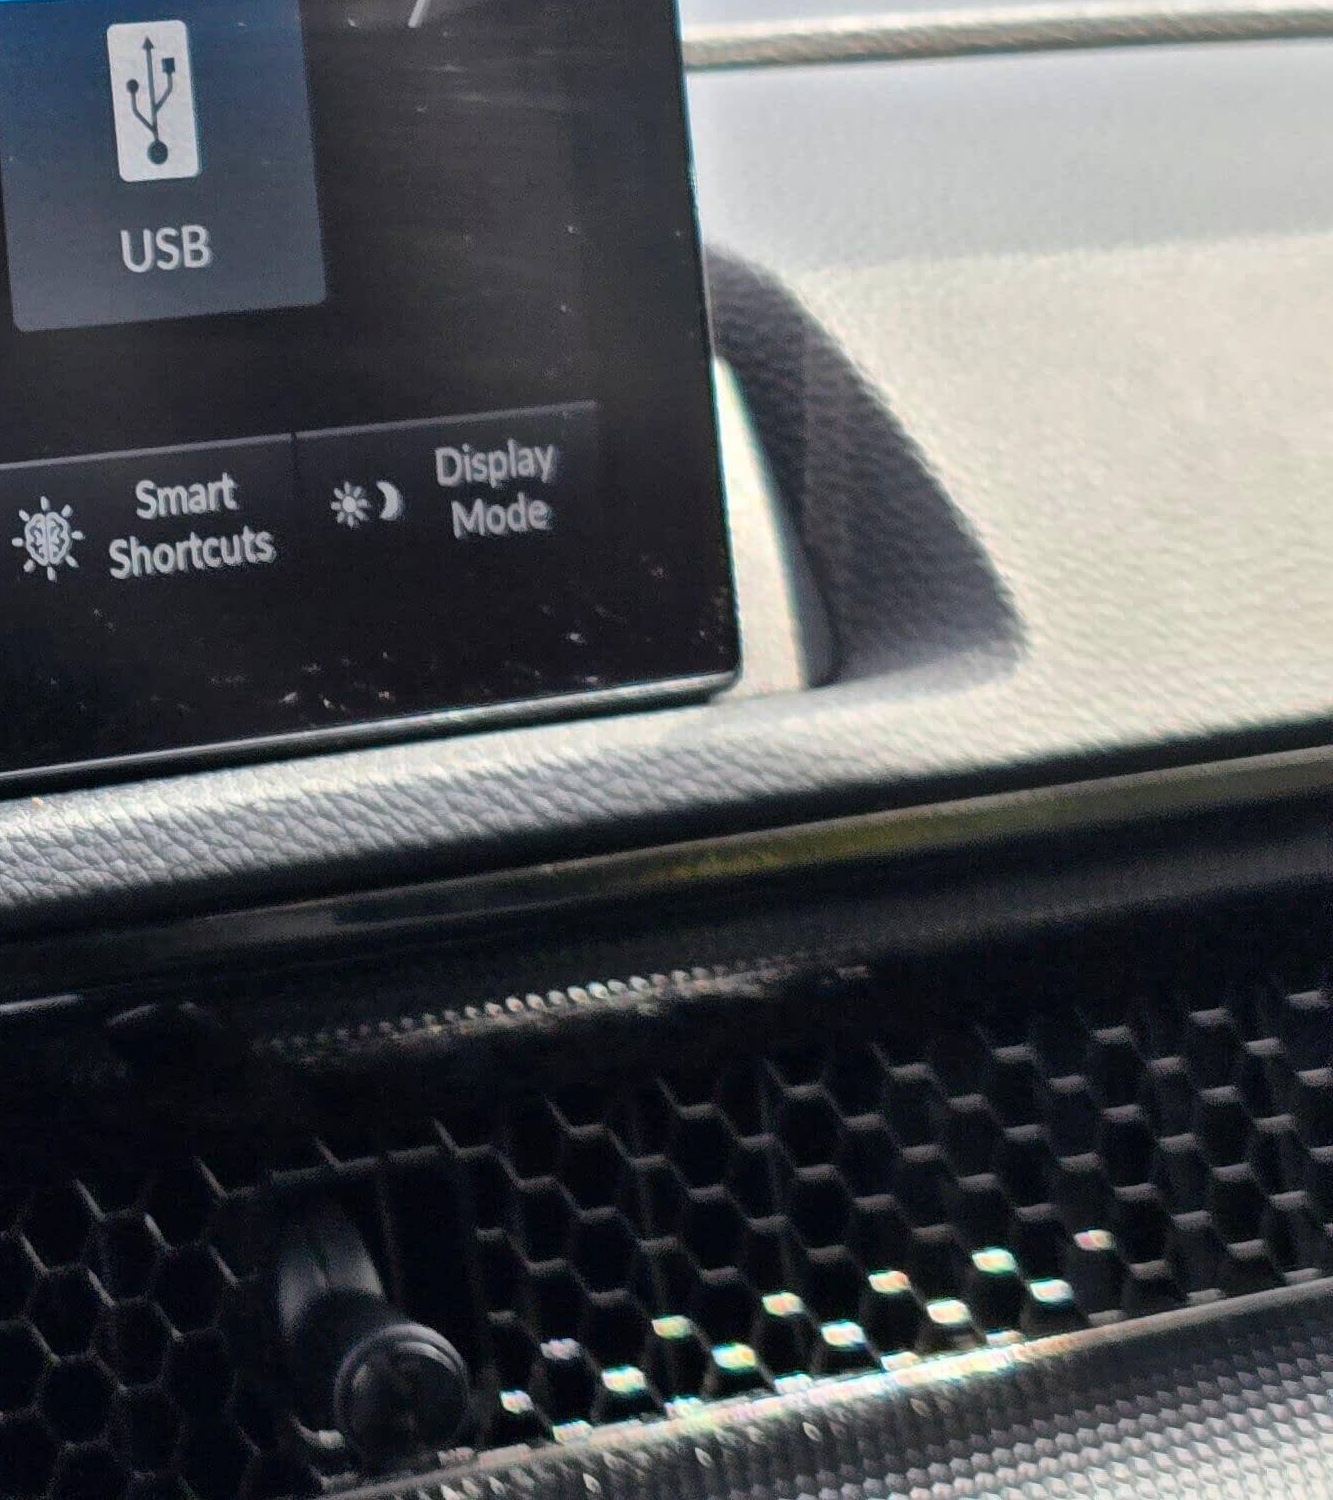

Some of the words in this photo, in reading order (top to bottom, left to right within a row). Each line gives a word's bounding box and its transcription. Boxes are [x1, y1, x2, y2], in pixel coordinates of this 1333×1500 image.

[120, 224, 211, 273] USB
[434, 438, 556, 489] Display
[135, 472, 238, 520] Smart
[450, 491, 551, 539] Mode
[108, 525, 277, 580] Shortcuts
